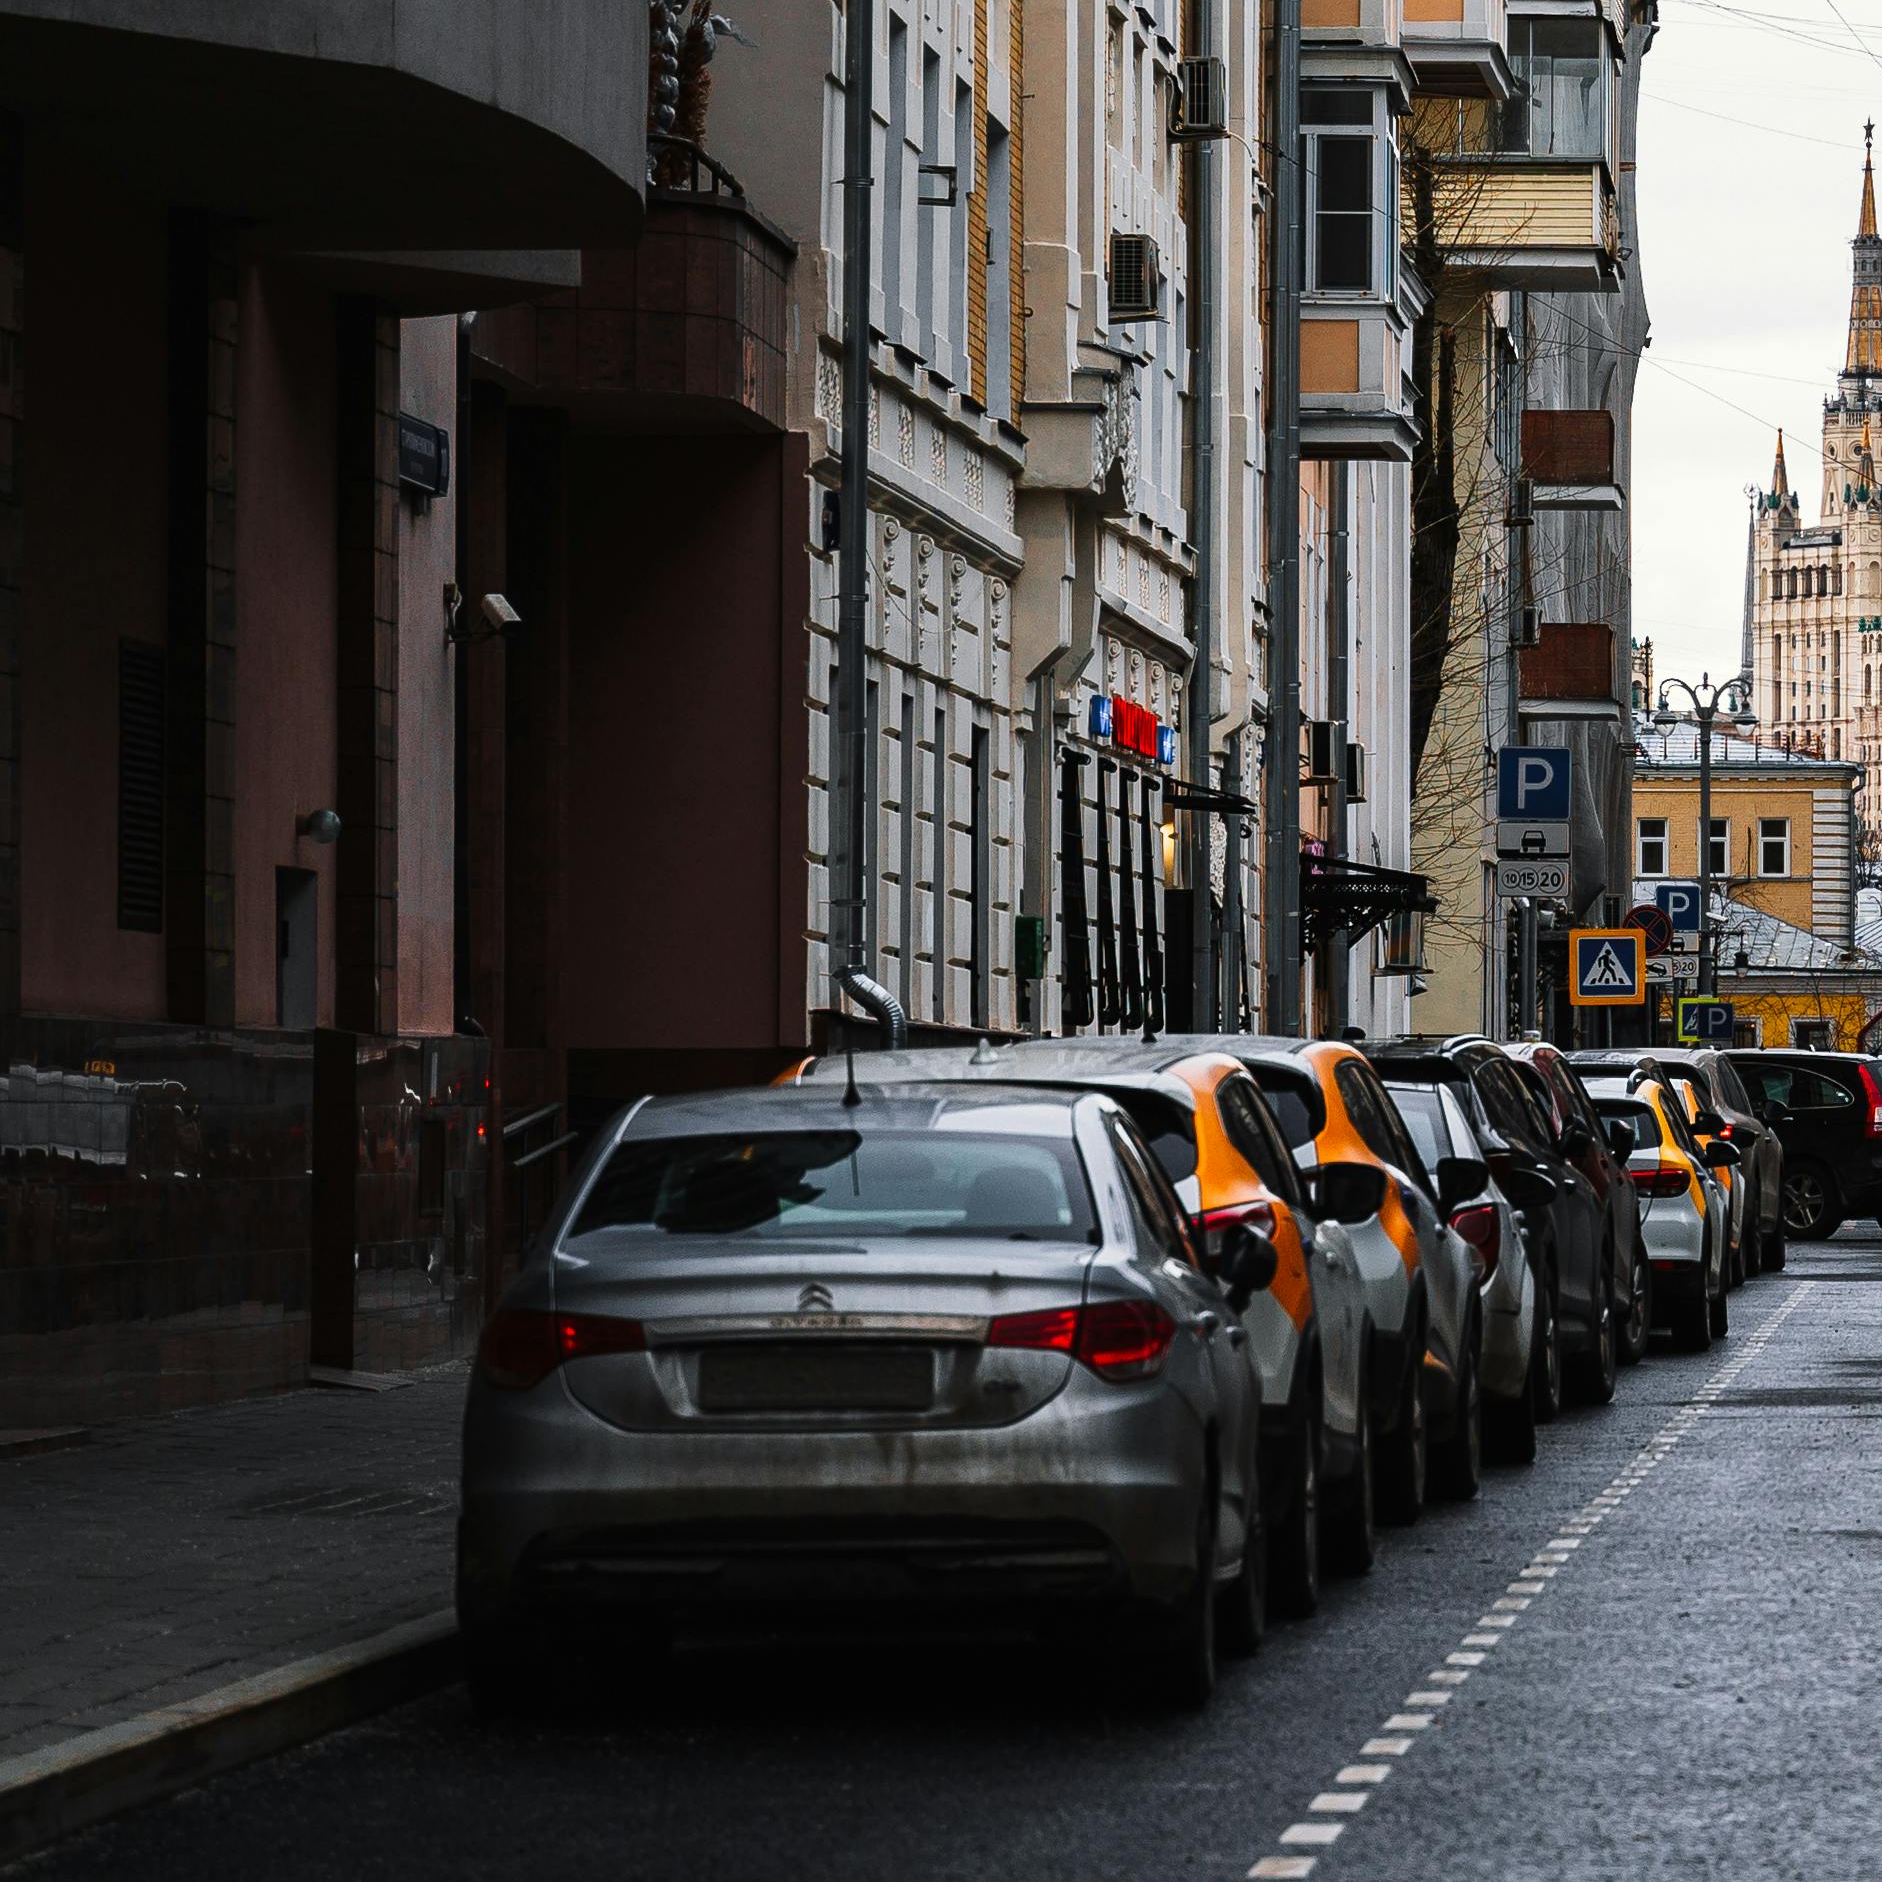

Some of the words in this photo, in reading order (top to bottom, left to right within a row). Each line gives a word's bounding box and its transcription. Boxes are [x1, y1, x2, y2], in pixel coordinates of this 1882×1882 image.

[1517, 756, 1554, 810] P
[1505, 873, 1517, 886] 10
[1520, 871, 1536, 887] 15
[1540, 871, 1561, 887] 20
[1668, 891, 1690, 922] P
[1682, 961, 1694, 972] 20
[1708, 1007, 1728, 1035] P
